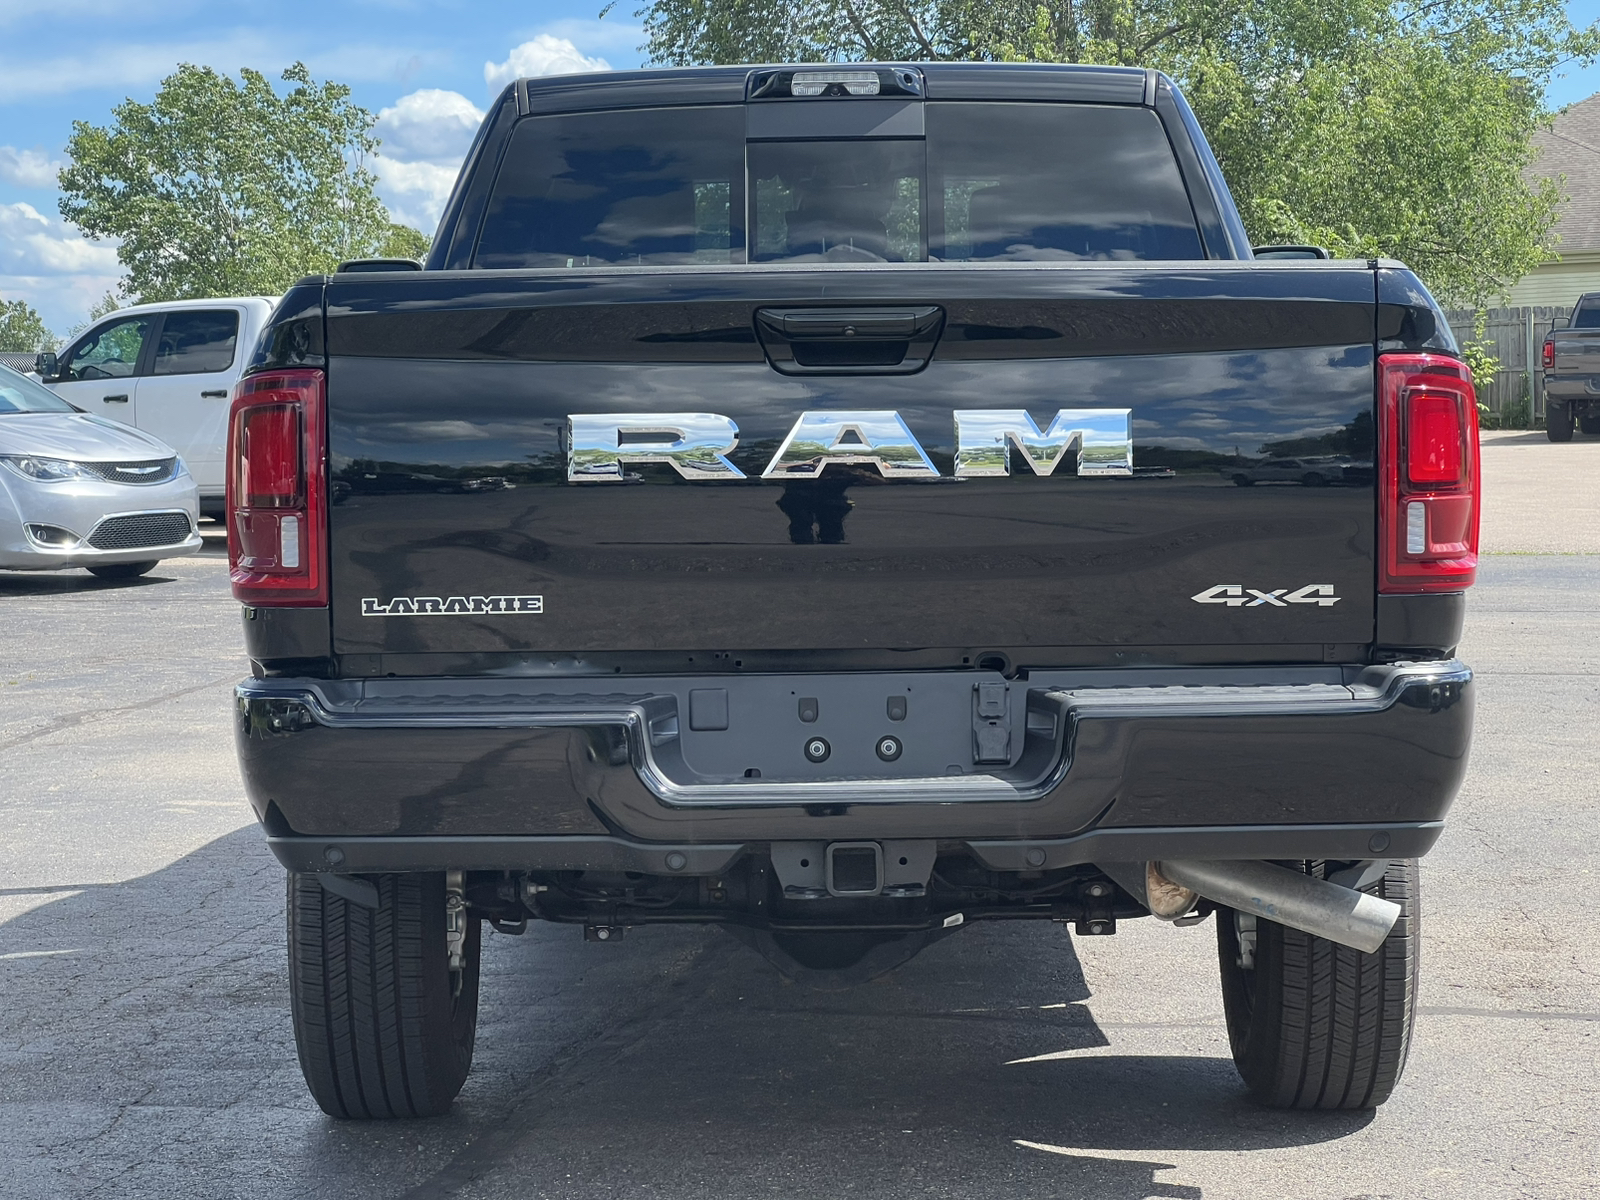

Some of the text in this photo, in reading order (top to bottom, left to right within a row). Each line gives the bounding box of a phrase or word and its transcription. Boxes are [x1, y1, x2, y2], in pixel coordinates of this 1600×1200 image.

[567, 408, 1133, 481] RAM
[361, 595, 544, 617] LARAMIE
[1191, 584, 1342, 607] 4x4
